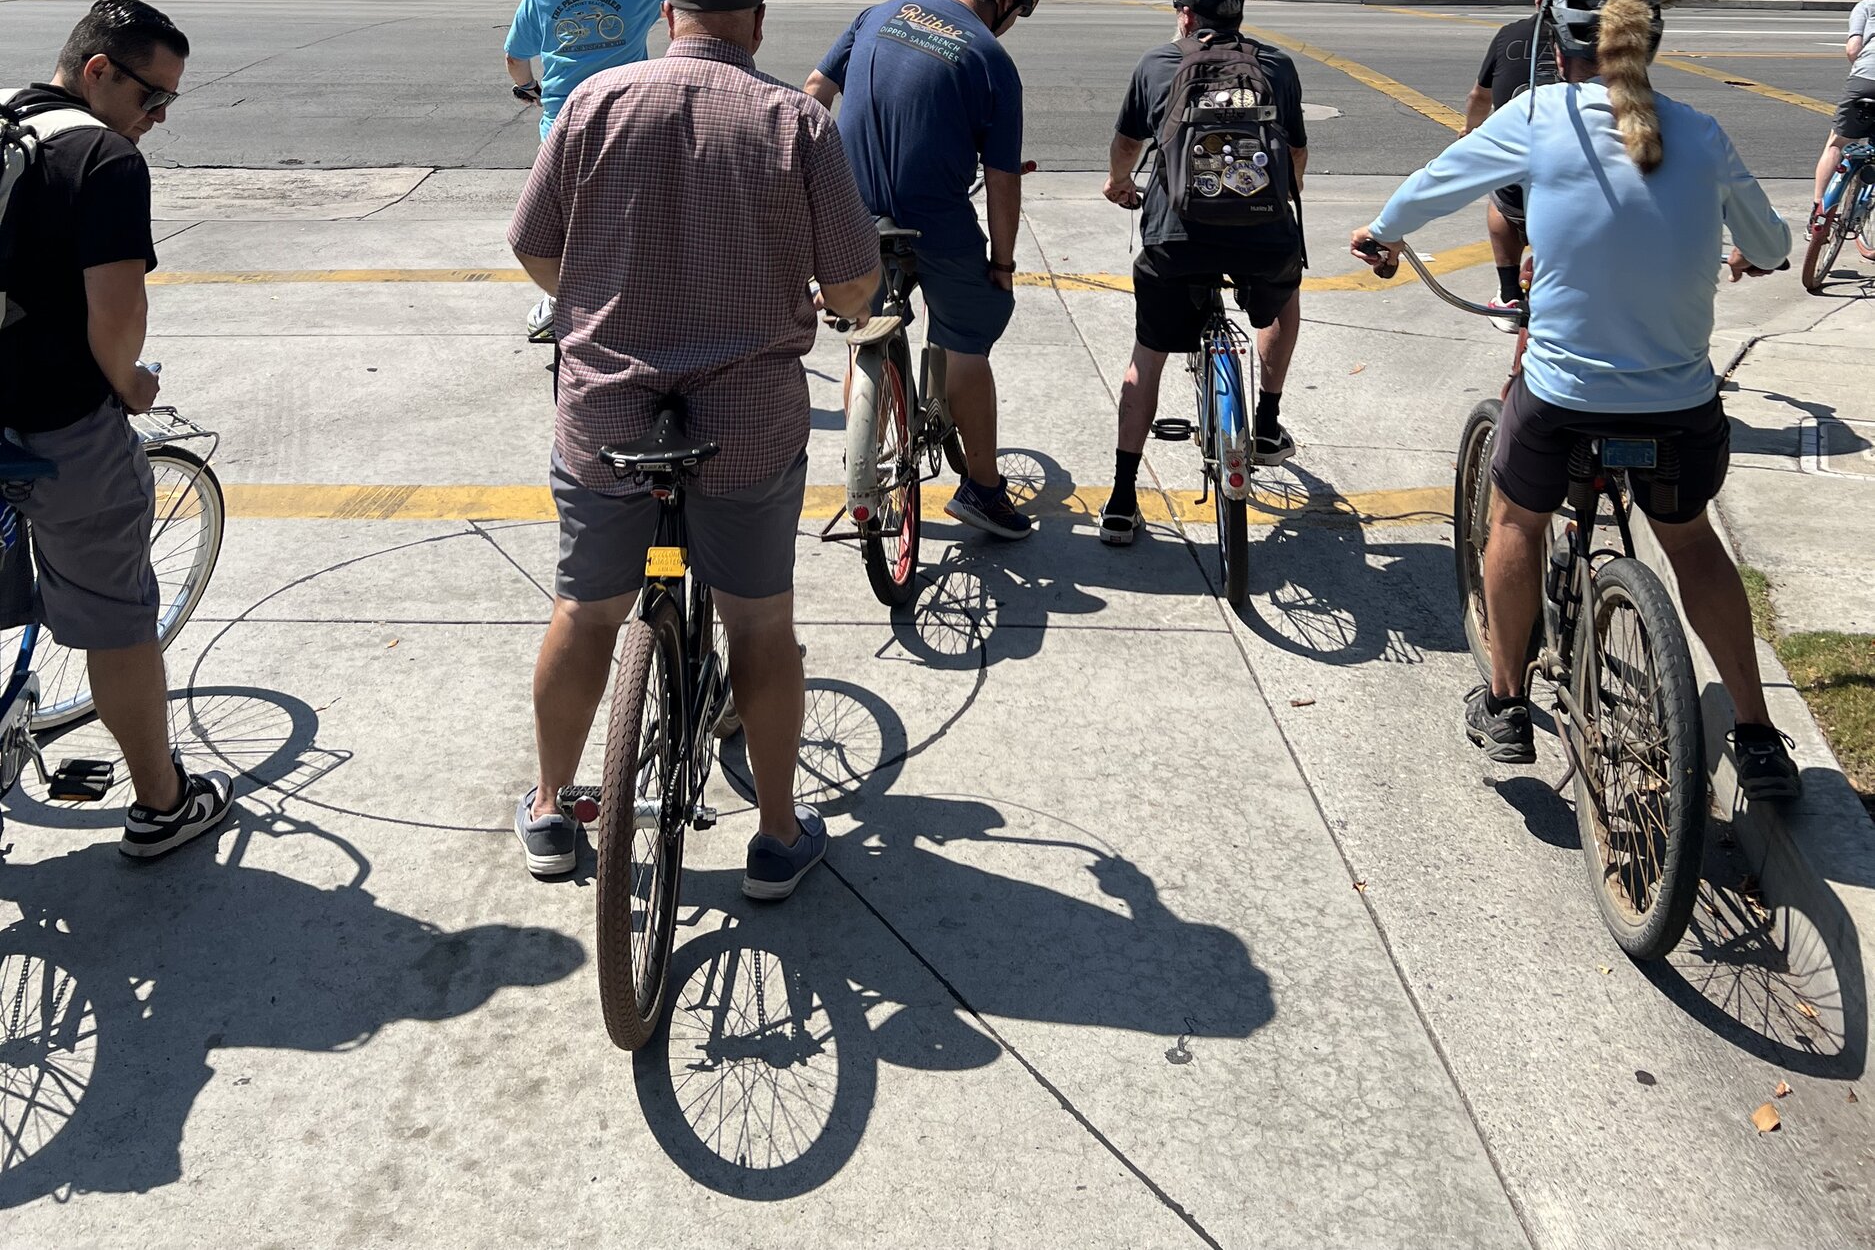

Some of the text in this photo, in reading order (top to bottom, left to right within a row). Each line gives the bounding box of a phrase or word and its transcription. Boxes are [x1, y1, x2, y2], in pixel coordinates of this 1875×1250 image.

[551, 5, 564, 21] THE
[896, 3, 963, 37] Philippe
[880, 26, 907, 39] DIPPED
[910, 35, 960, 63] SANDWICHES
[928, 34, 960, 52] FRENCH
[1225, 163, 1265, 179] OCEANSIDE
